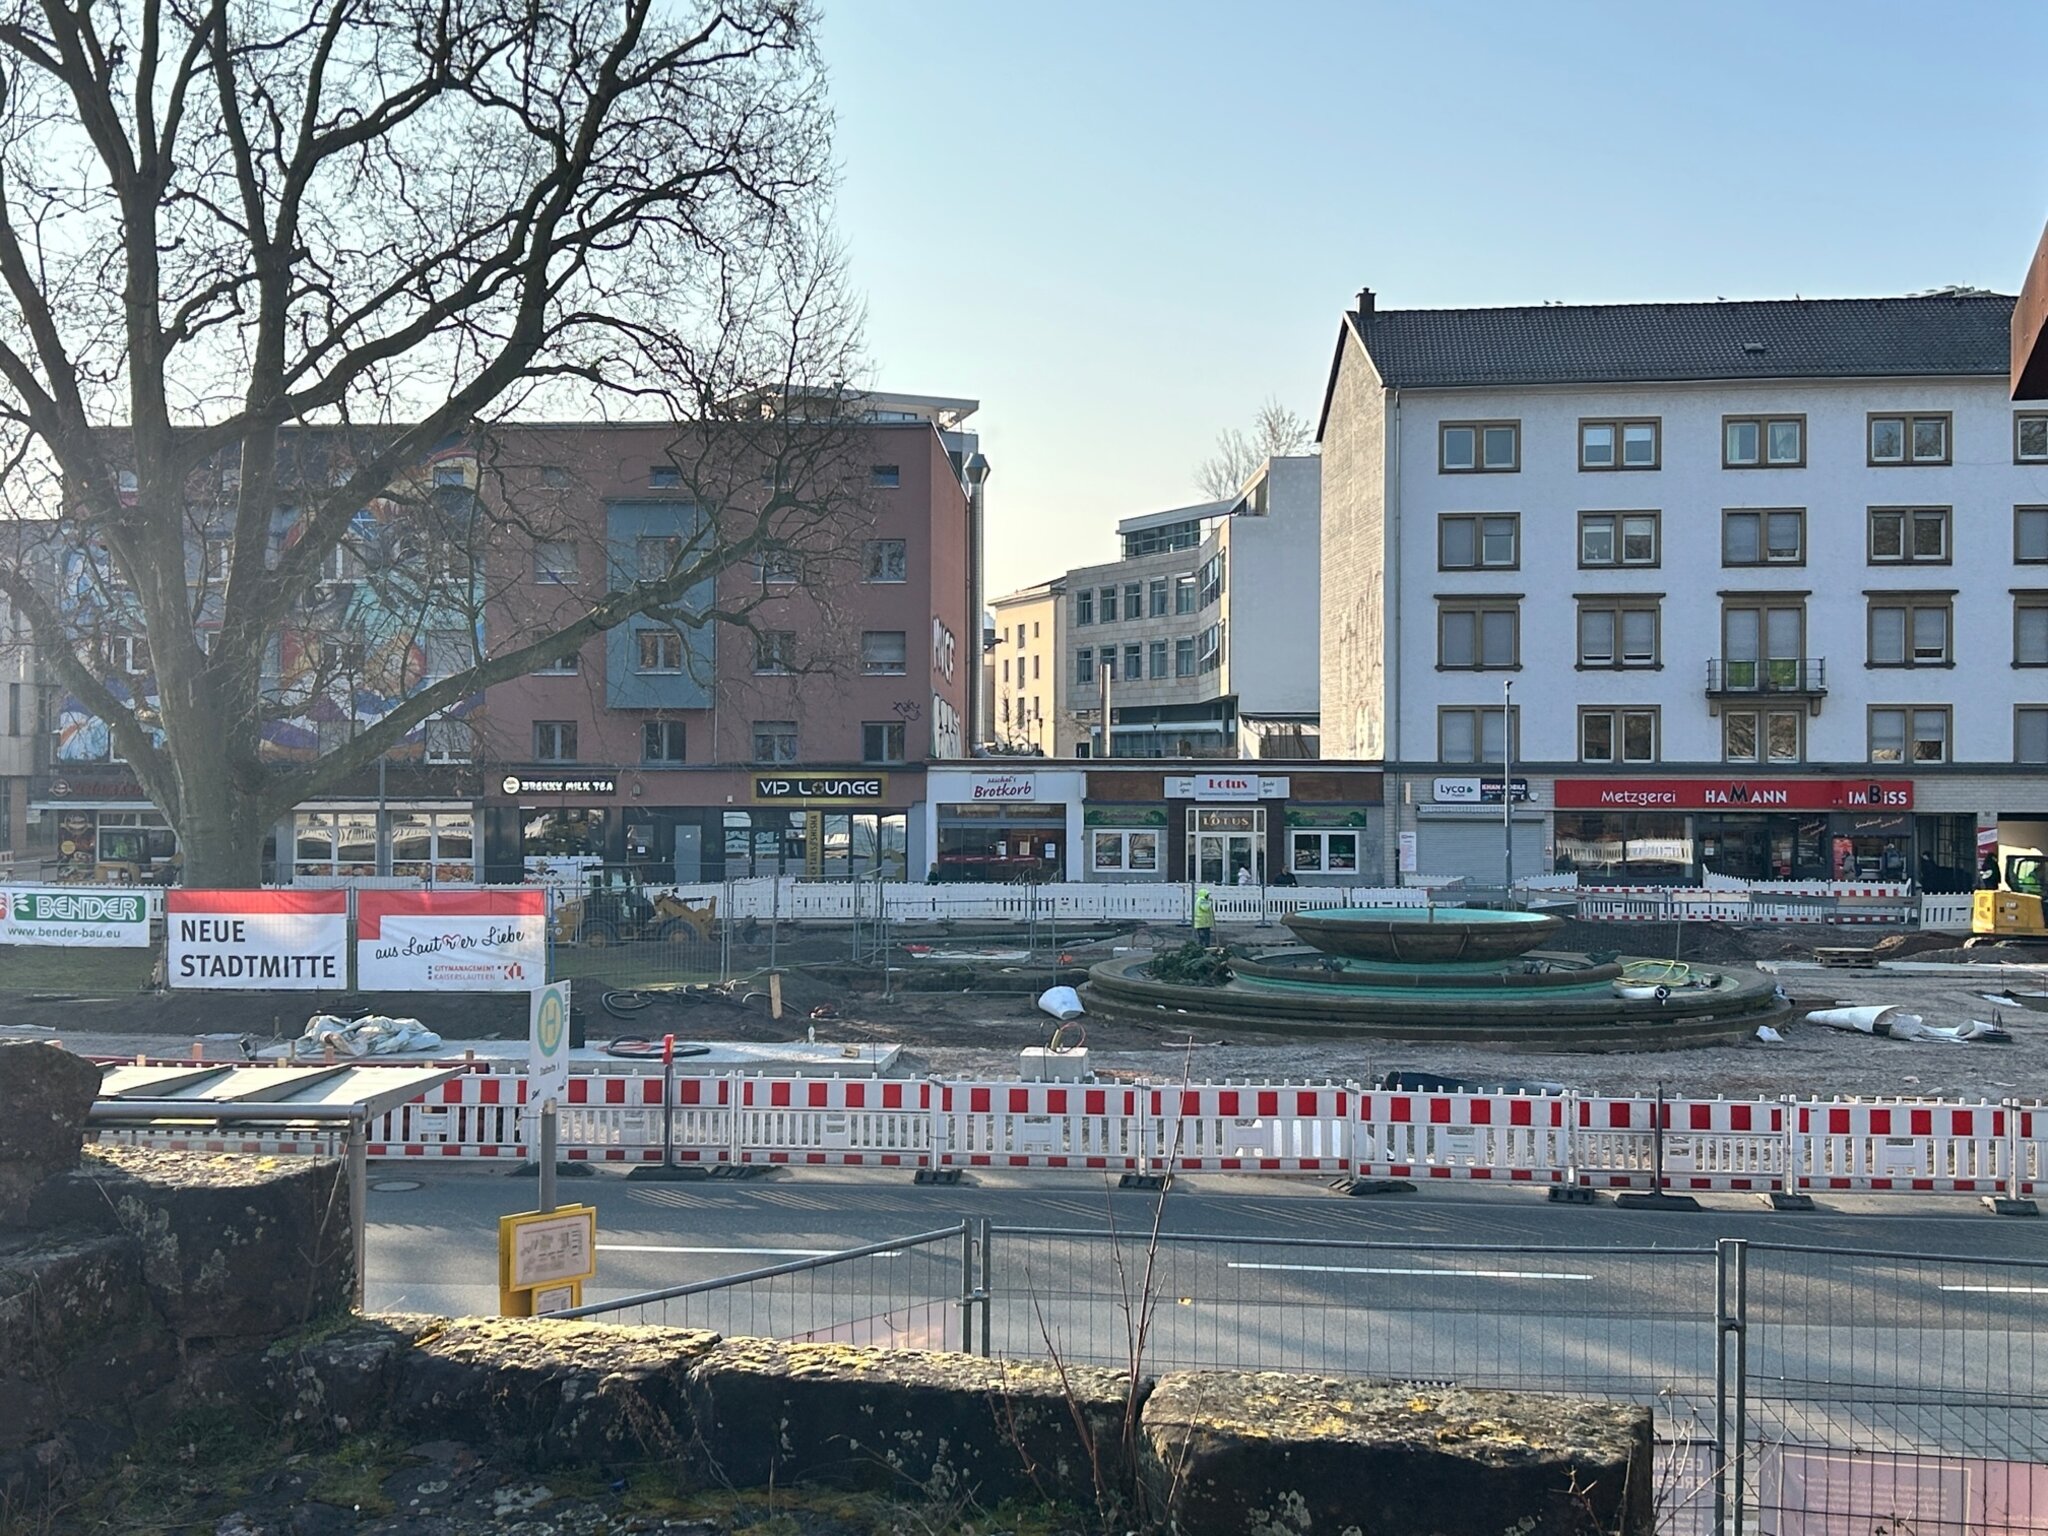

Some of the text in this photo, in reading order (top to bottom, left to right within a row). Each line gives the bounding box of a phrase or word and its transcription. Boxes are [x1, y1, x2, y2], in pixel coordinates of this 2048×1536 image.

[565, 781, 590, 791] MILK
[592, 781, 613, 791] TEA
[760, 781, 790, 795] VIP
[974, 781, 1032, 798] Brotkorb
[1208, 779, 1248, 789] Lotus
[1440, 784, 1465, 795] Lyca
[1600, 790, 1676, 805] Metzgerei
[1203, 816, 1249, 826] LOTUS
[36, 896, 137, 921] BENDER
[8, 926, 121, 939] www.bender-bau.eu
[181, 919, 246, 943] NEUE
[375, 947, 398, 960] aus
[481, 925, 526, 946] Liebe
[181, 955, 336, 979] STADTMITTE
[434, 973, 495, 981] KAISERSLAUTERN
